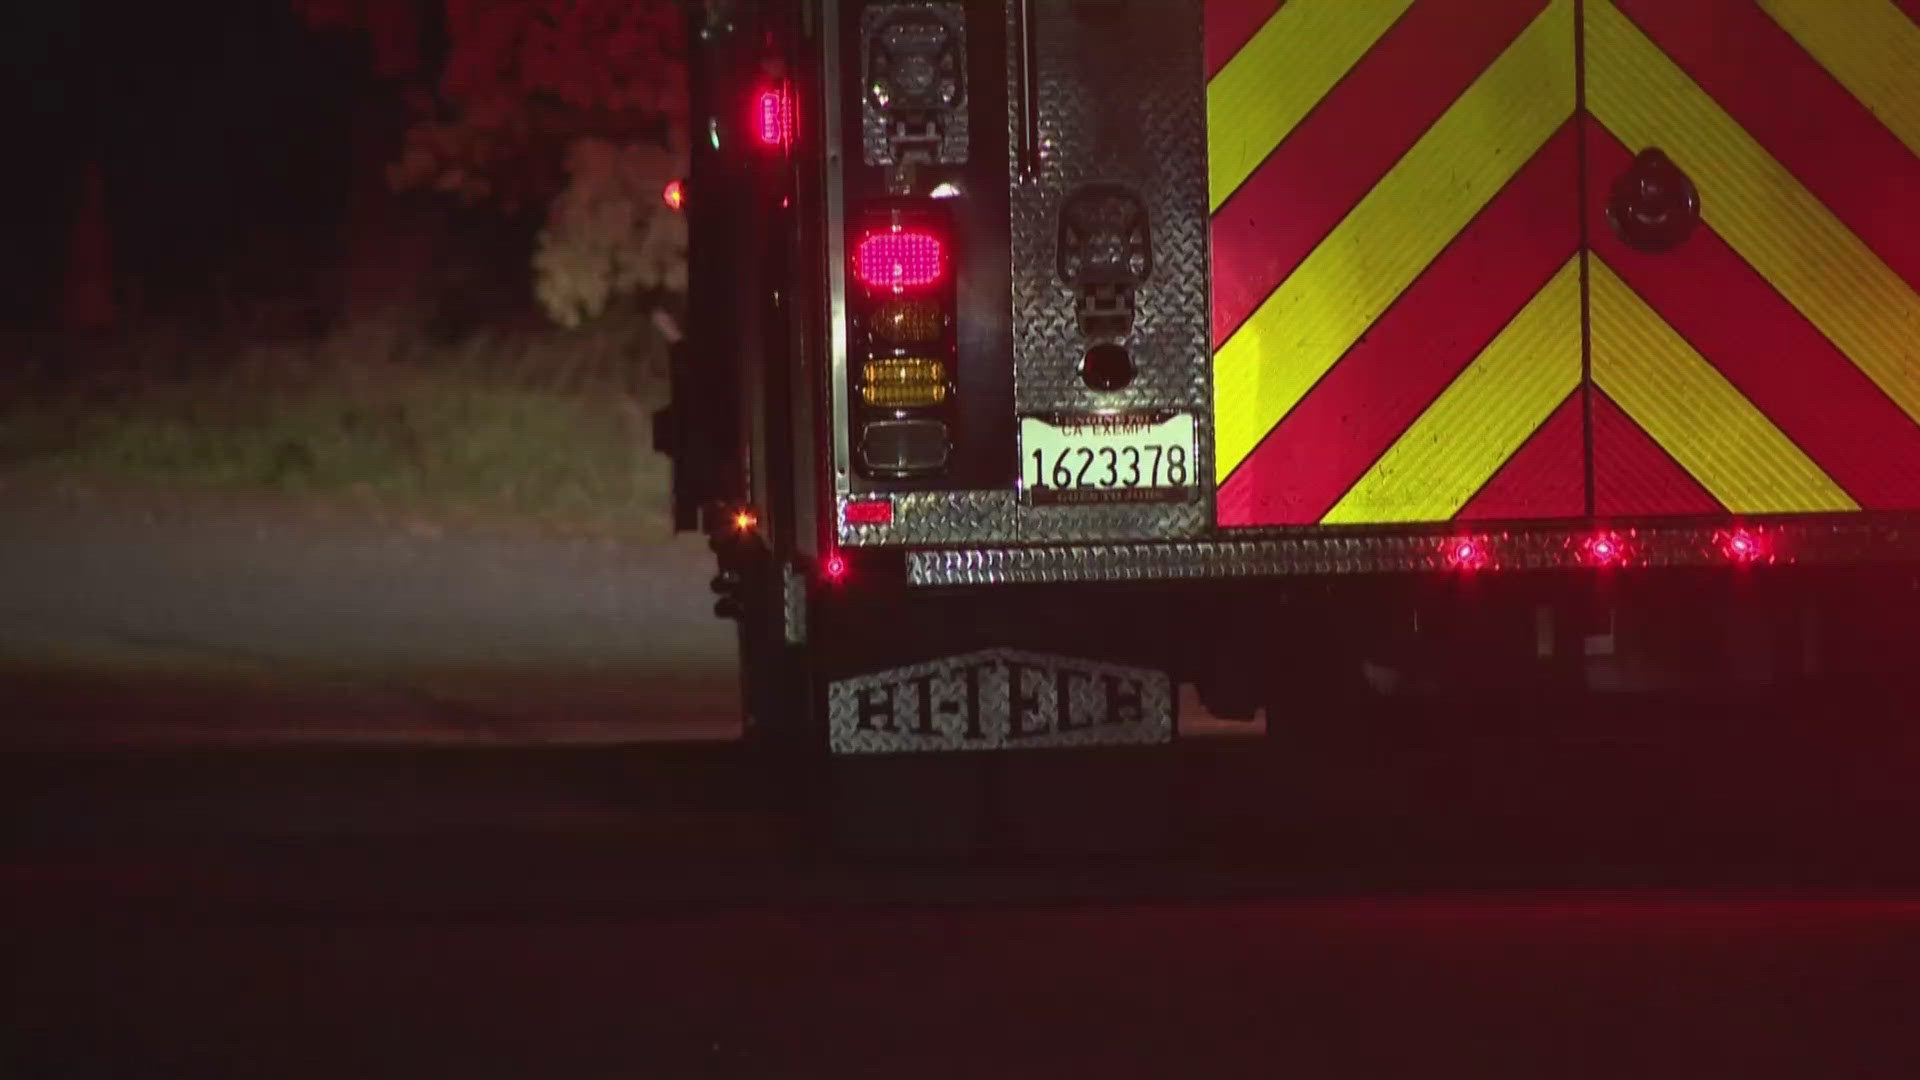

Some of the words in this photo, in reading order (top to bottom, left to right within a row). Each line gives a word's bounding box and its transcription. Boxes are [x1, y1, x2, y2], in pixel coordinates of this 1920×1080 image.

[1062, 422, 1083, 436] CA
[1092, 421, 1152, 435] EXEMPT
[1031, 445, 1187, 488] 1623378
[855, 659, 1145, 739] HI-TECH
